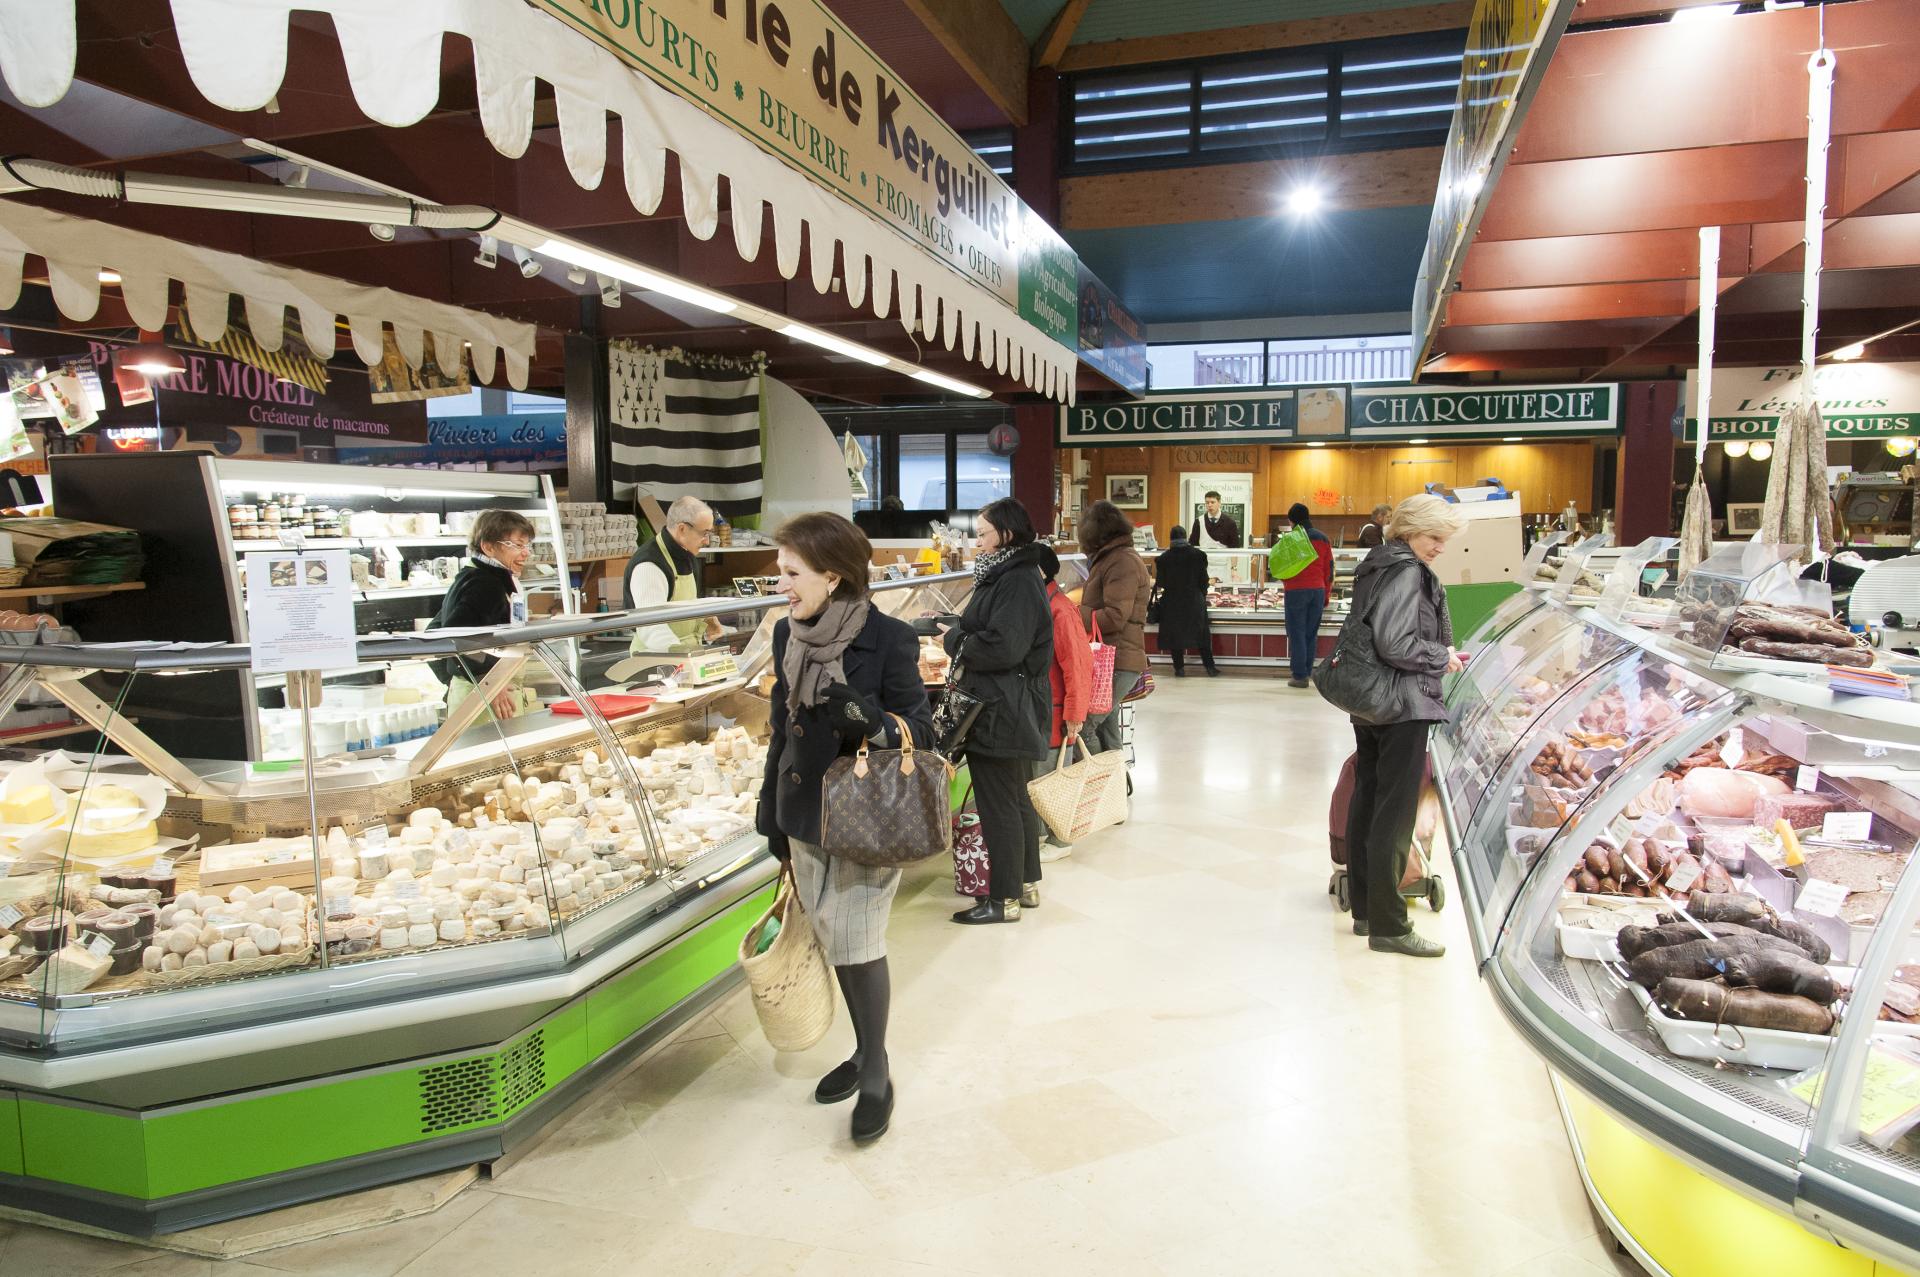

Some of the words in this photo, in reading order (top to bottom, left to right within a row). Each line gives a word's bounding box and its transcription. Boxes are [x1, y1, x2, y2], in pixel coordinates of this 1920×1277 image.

[812, 28, 863, 127] de
[876, 74, 1010, 250] Kerguillet
[758, 87, 851, 182] BEURRE
[876, 174, 954, 255] FROMAGES
[968, 245, 1002, 289] OEUFS
[1034, 290, 1067, 334] Biologique
[250, 405, 310, 428] Créateur
[313, 412, 330, 430] de
[333, 417, 390, 435] macarons
[1080, 401, 1282, 432] BOUCHERIE
[1365, 390, 1595, 424] CHARCUTERIE
[1737, 396, 1889, 414] Légmes
[430, 420, 498, 445] Viviers
[510, 420, 546, 443] des
[1712, 417, 1910, 435] BIOLIQUES
